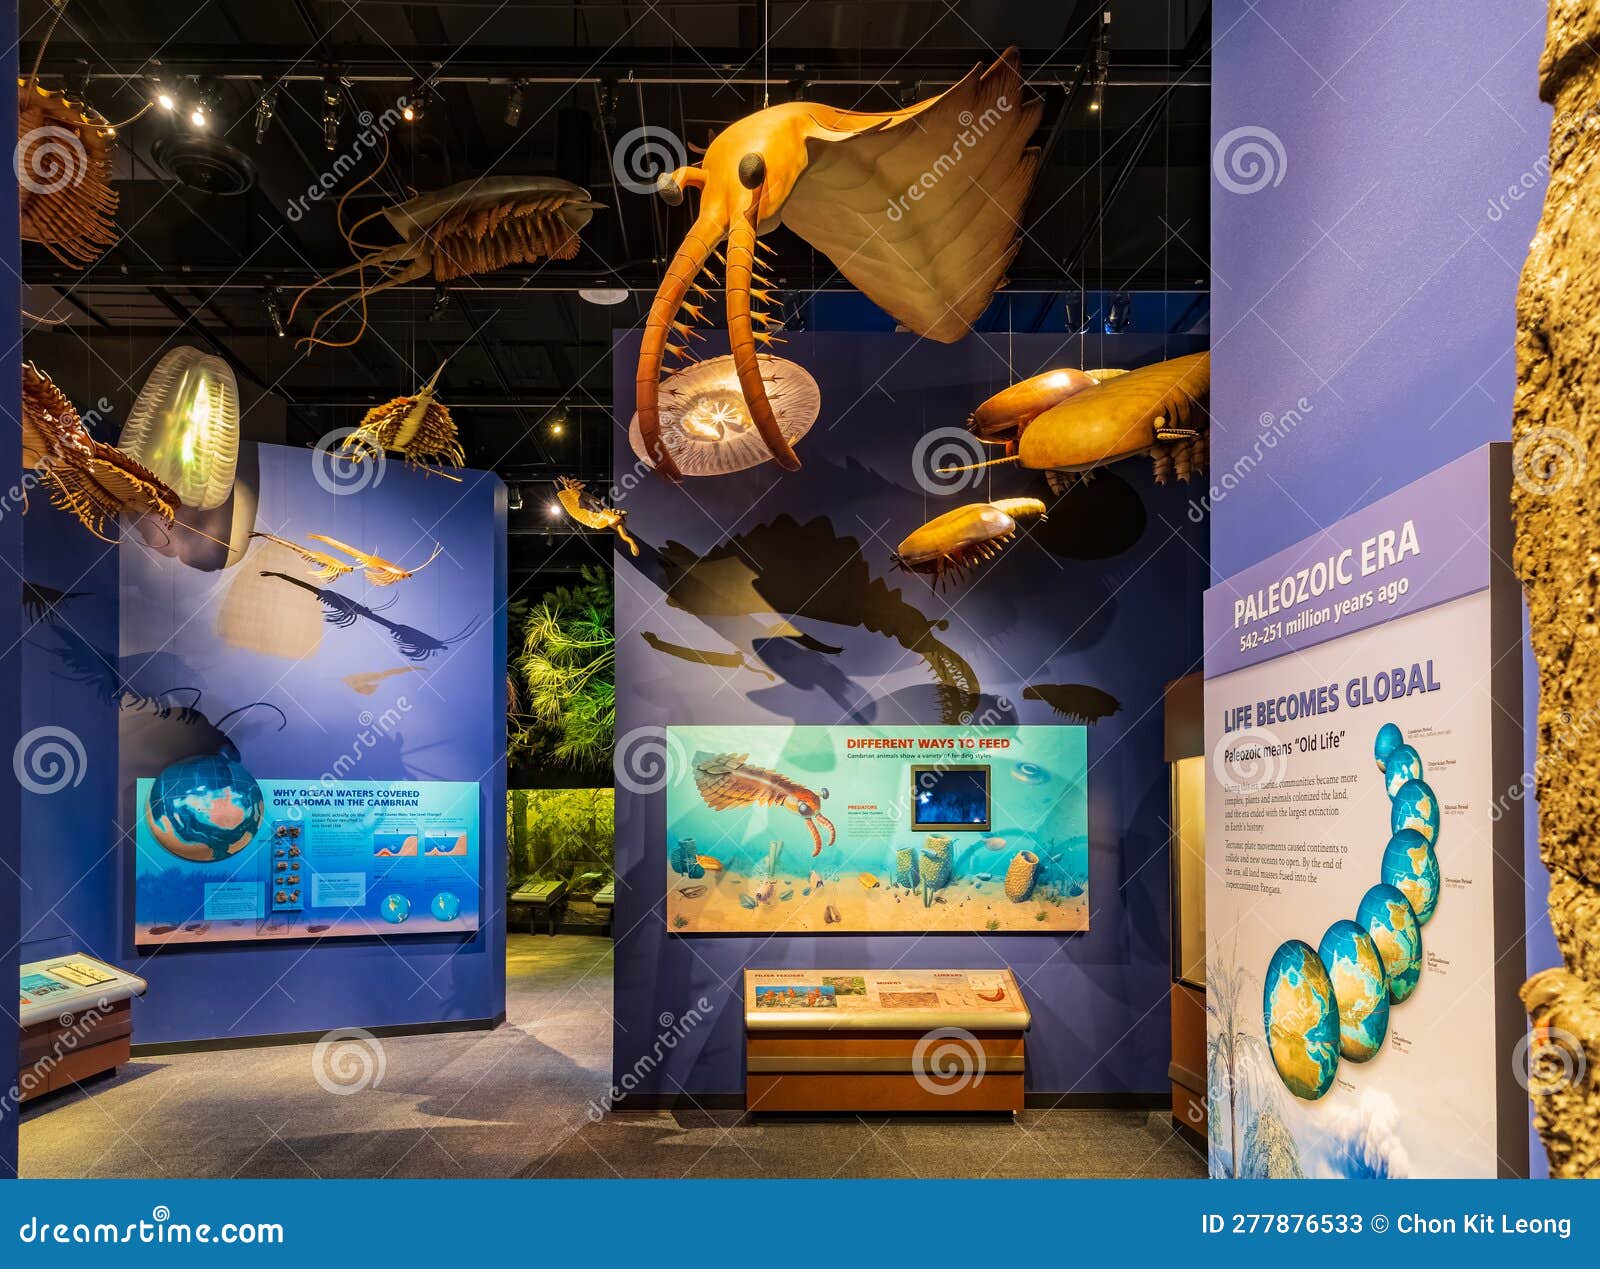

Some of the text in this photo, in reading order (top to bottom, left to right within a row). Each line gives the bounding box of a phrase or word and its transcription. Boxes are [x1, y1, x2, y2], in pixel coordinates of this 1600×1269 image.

[1234, 519, 1420, 628] PALEOZOIC ERA
[1286, 606, 1330, 636] million
[1334, 589, 1373, 624] years
[1378, 577, 1409, 605] ago
[1224, 659, 1441, 733] LIFE BECOMES GLOBAL
[847, 738, 1010, 749] DIFFERENT WAYS TO FEED
[1224, 746, 1262, 763] Paleozoic
[1263, 741, 1292, 757] means
[1316, 774, 1339, 785] became
[1340, 774, 1358, 783] more
[273, 789, 420, 798] WHY OCEAN WATERS COVERED
[1321, 789, 1331, 800] the
[273, 798, 418, 807] OKLAHOMA IN THE CAMBRIAN
[1289, 807, 1307, 819] largest
[1308, 807, 1339, 816] extinction
[1287, 842, 1305, 852] caused
[1307, 843, 1339, 853] continents
[1341, 845, 1348, 853] to
[1302, 856, 1310, 870] By
[1311, 858, 1321, 868] the
[1322, 858, 1334, 868] end
[1335, 858, 1342, 869] of
[1279, 870, 1294, 881] fused
[1295, 871, 1307, 882] into
[1307, 872, 1317, 883] the
